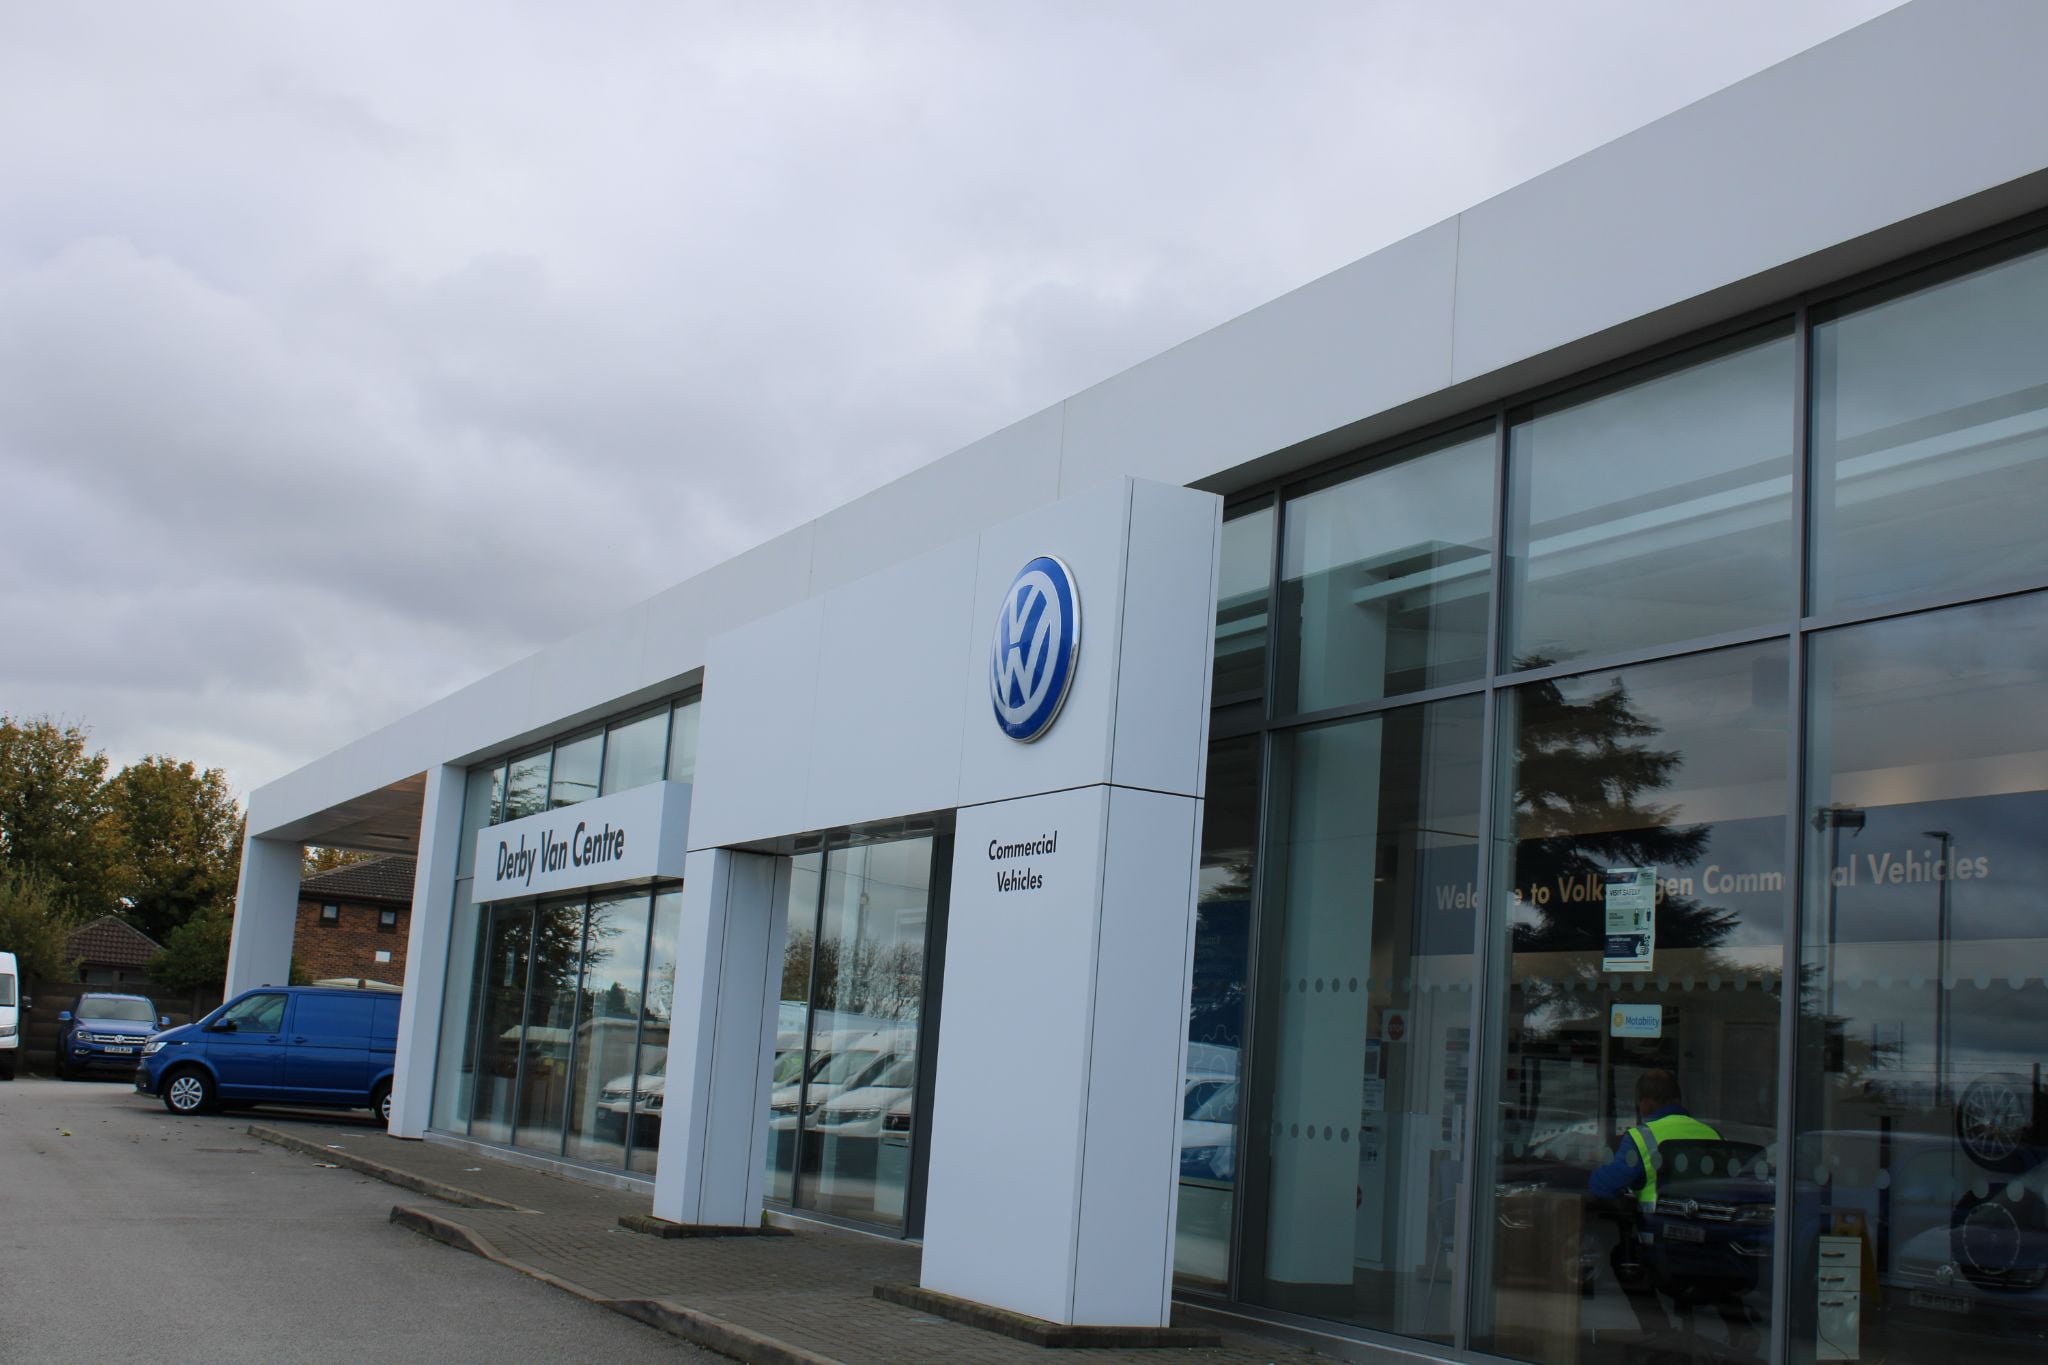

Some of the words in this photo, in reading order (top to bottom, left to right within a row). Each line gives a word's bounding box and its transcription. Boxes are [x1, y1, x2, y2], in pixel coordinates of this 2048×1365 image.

[496, 834, 537, 887] Derby
[541, 829, 568, 873] Van
[572, 821, 625, 868] Centre
[988, 831, 1058, 861] Commercial
[997, 868, 1043, 893] Vehicles
[1436, 882, 1523, 910] Welce
[1531, 883, 1550, 905] to
[1558, 873, 1694, 905] Volkgen
[1703, 854, 1857, 895] Commal
[1867, 846, 1989, 885] Vehicles
[1625, 1015, 1660, 1029] Motability
